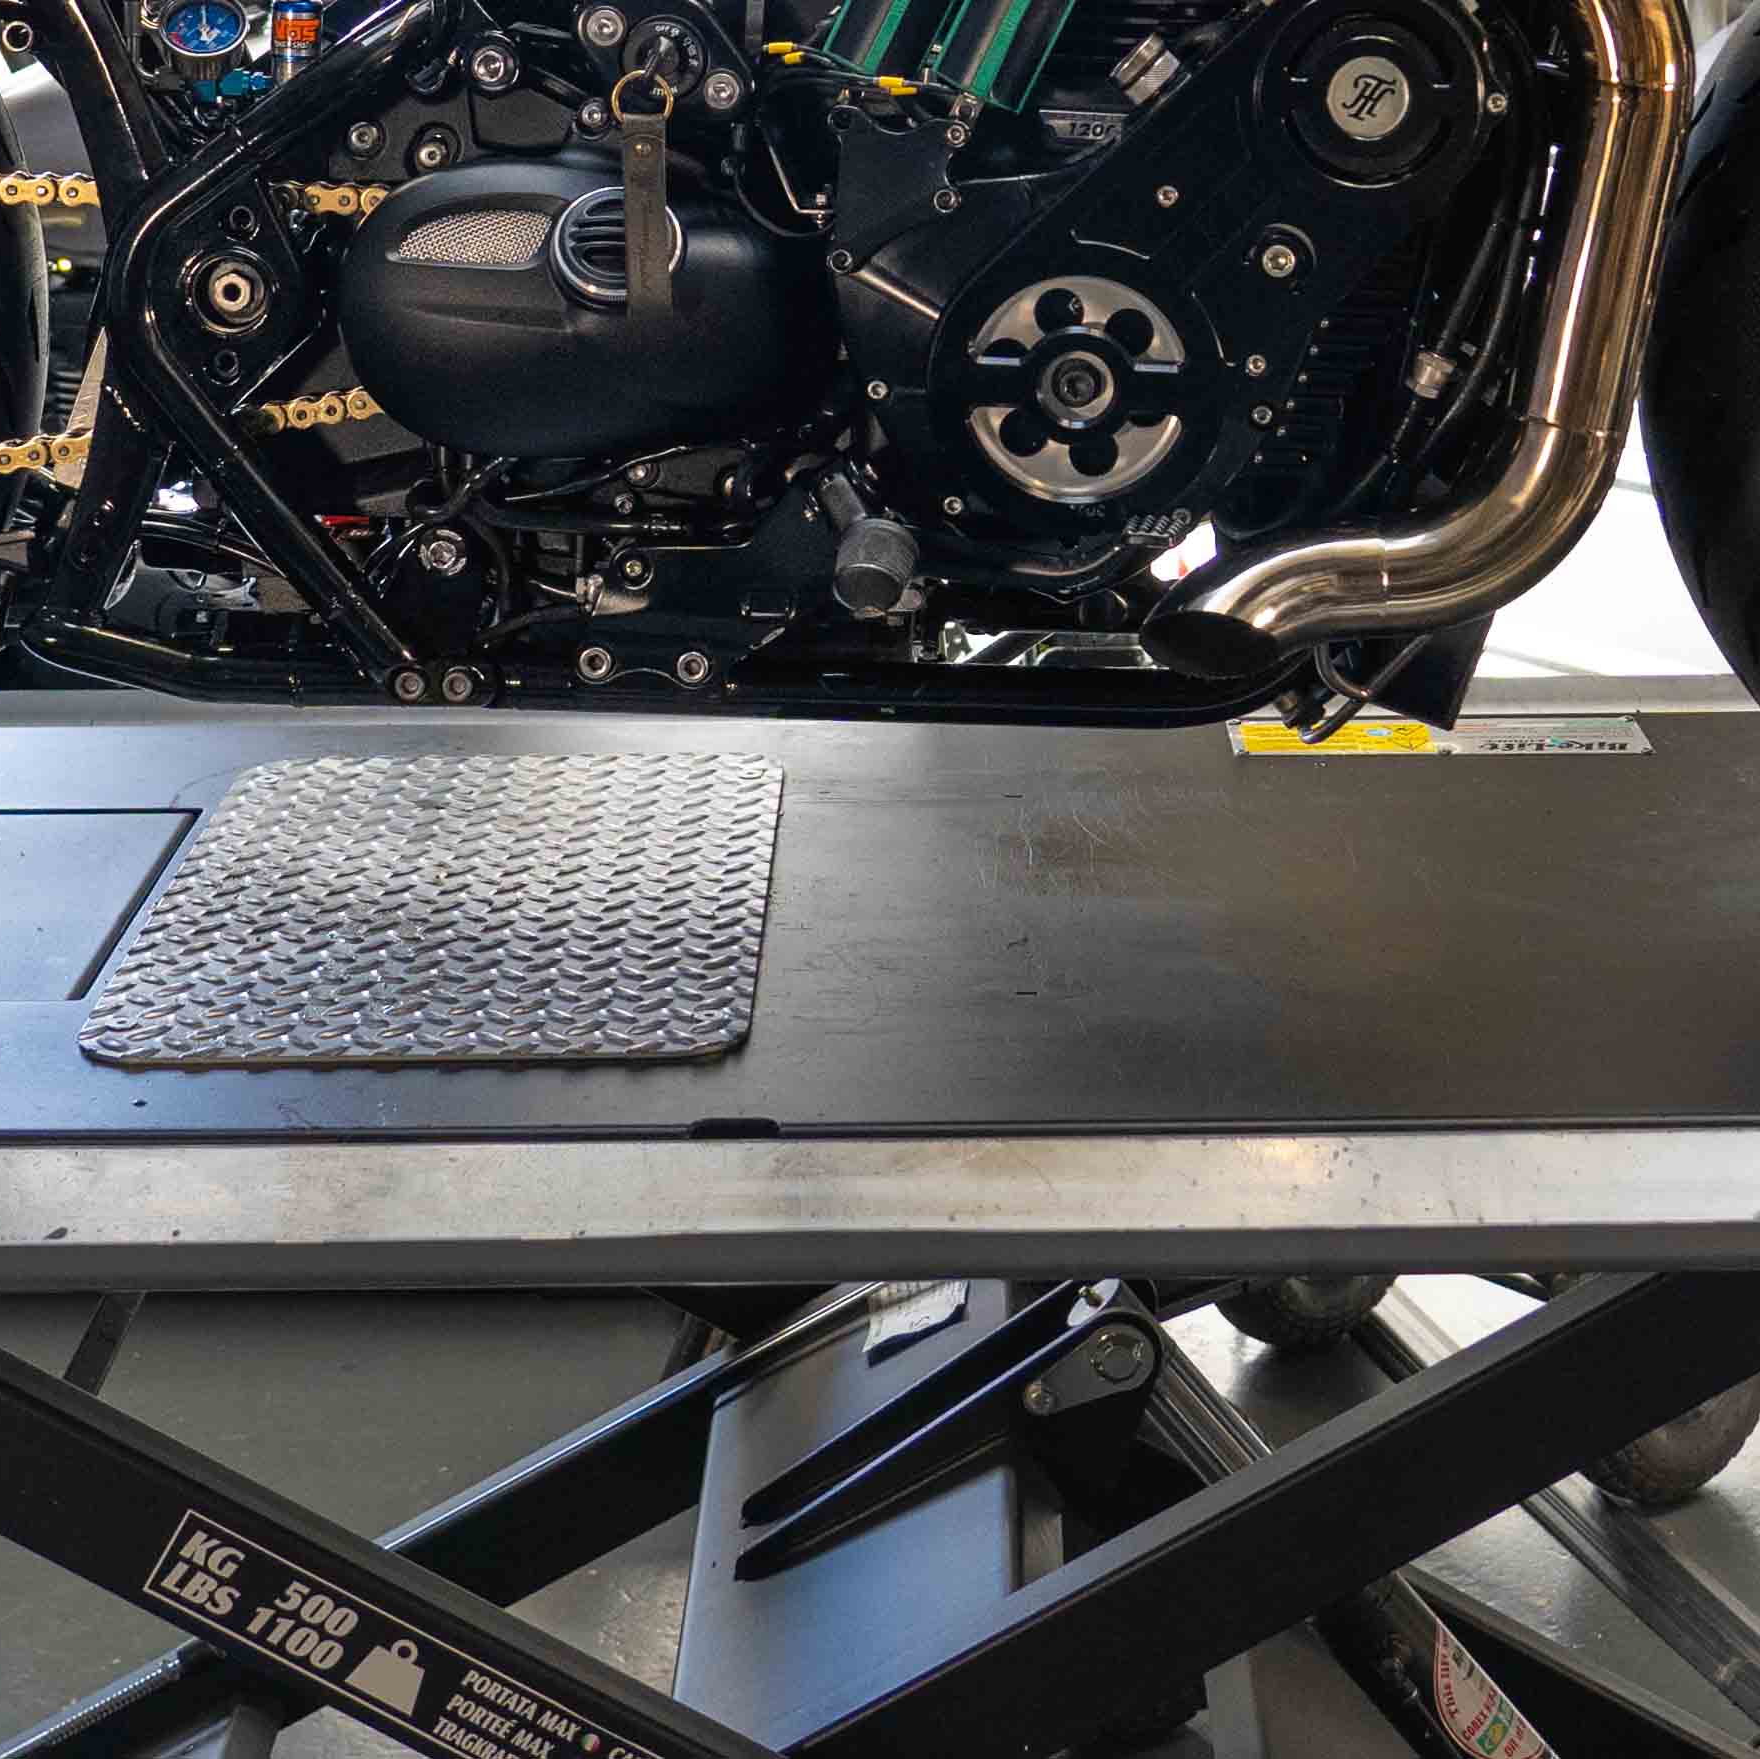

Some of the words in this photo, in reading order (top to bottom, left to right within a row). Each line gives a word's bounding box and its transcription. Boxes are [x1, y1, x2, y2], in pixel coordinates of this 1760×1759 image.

[159, 1562, 241, 1618] LBS
[245, 1606, 345, 1672] 1100
[178, 1530, 246, 1581] KG
[274, 1581, 360, 1639] 500
[460, 1669, 538, 1722] PORTATA
[537, 1709, 582, 1743] MAX
[511, 1729, 556, 1759] MAX
